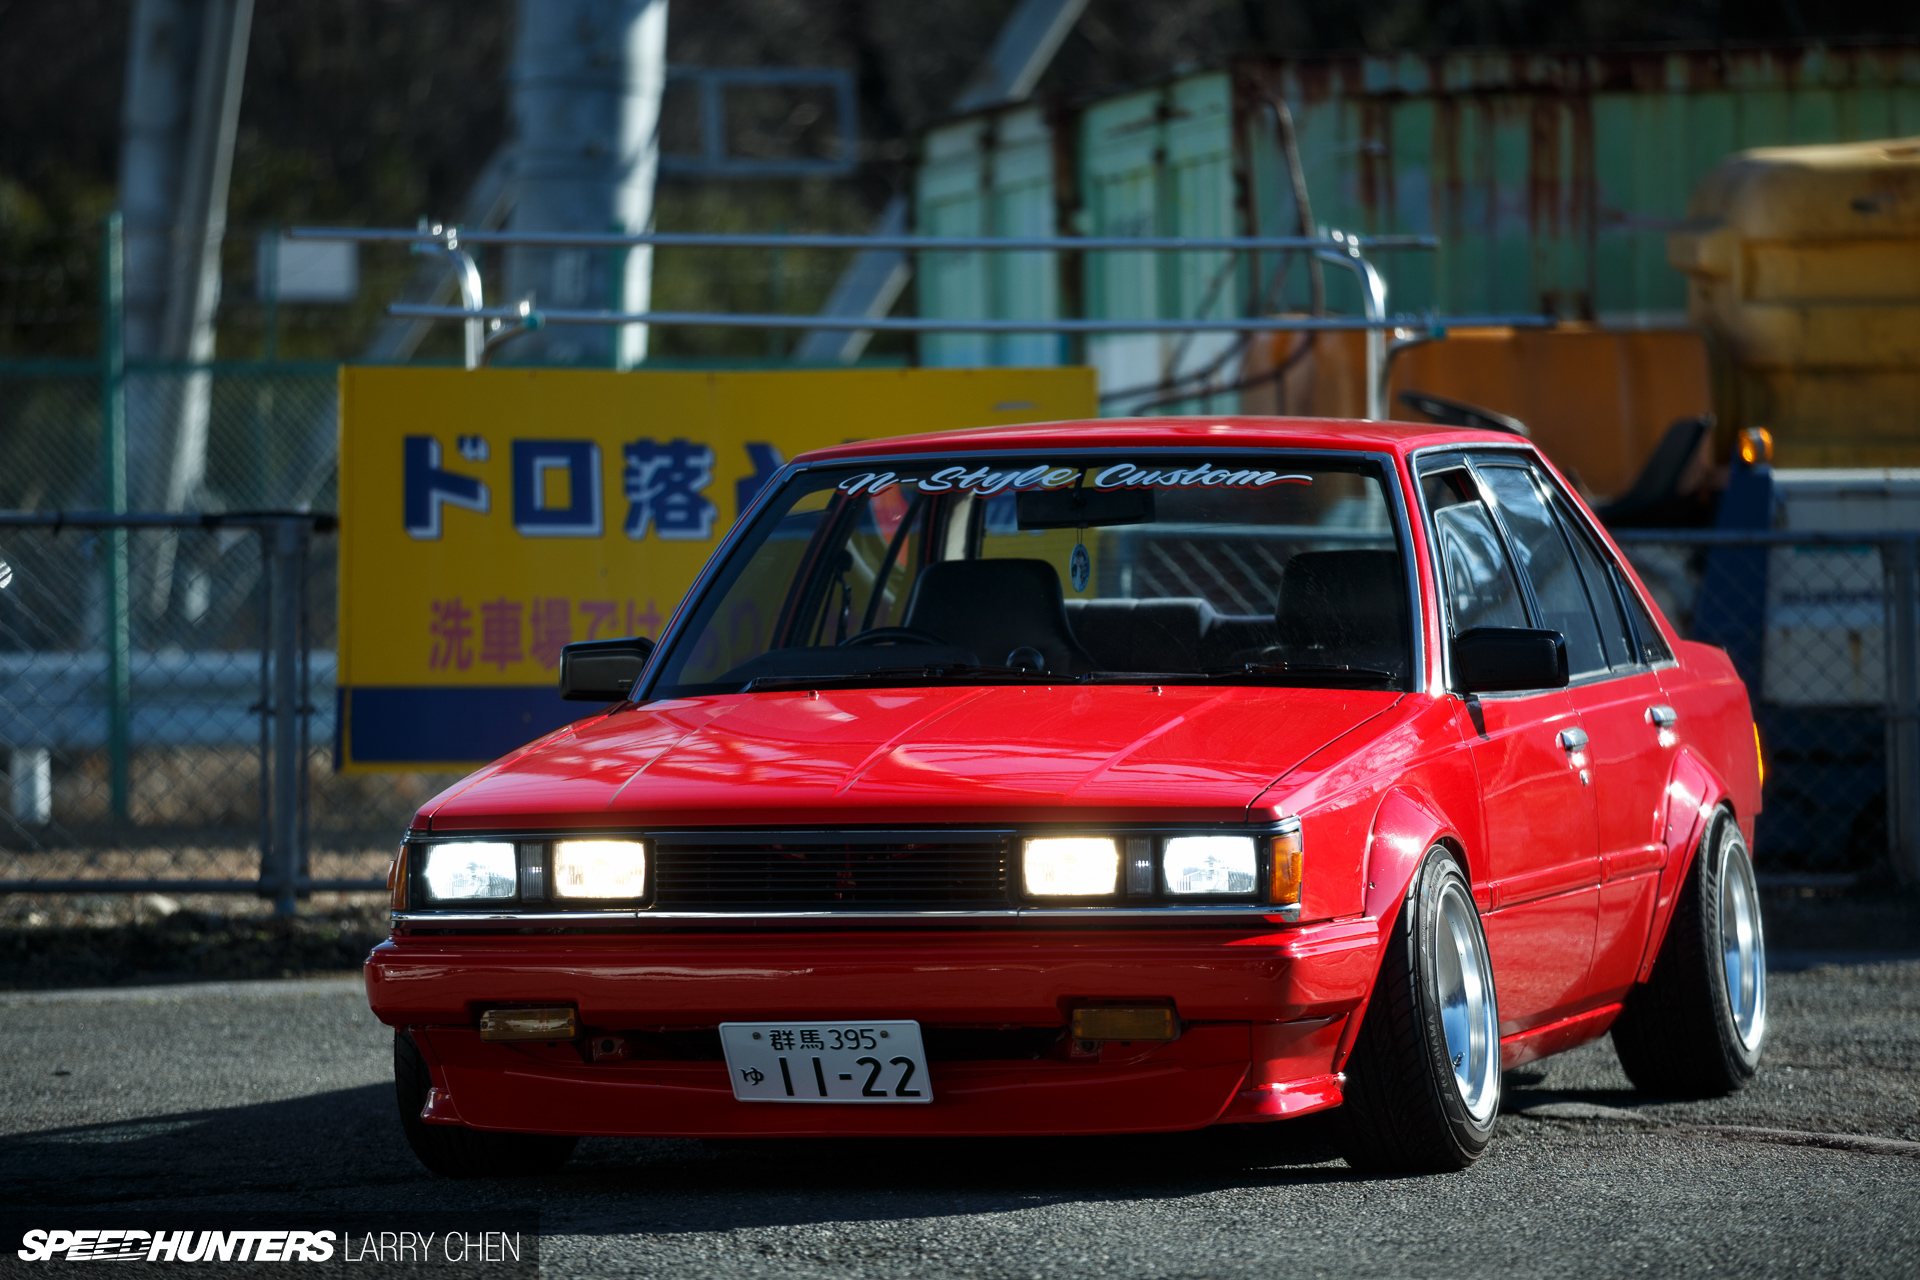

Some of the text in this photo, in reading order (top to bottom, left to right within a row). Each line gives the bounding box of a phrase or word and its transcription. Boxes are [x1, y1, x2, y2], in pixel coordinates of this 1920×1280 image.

[1094, 462, 1312, 492] Custom
[1427, 1013, 1449, 1088] YOKOHAMA
[740, 1056, 921, 1097] ゆ 11-22
